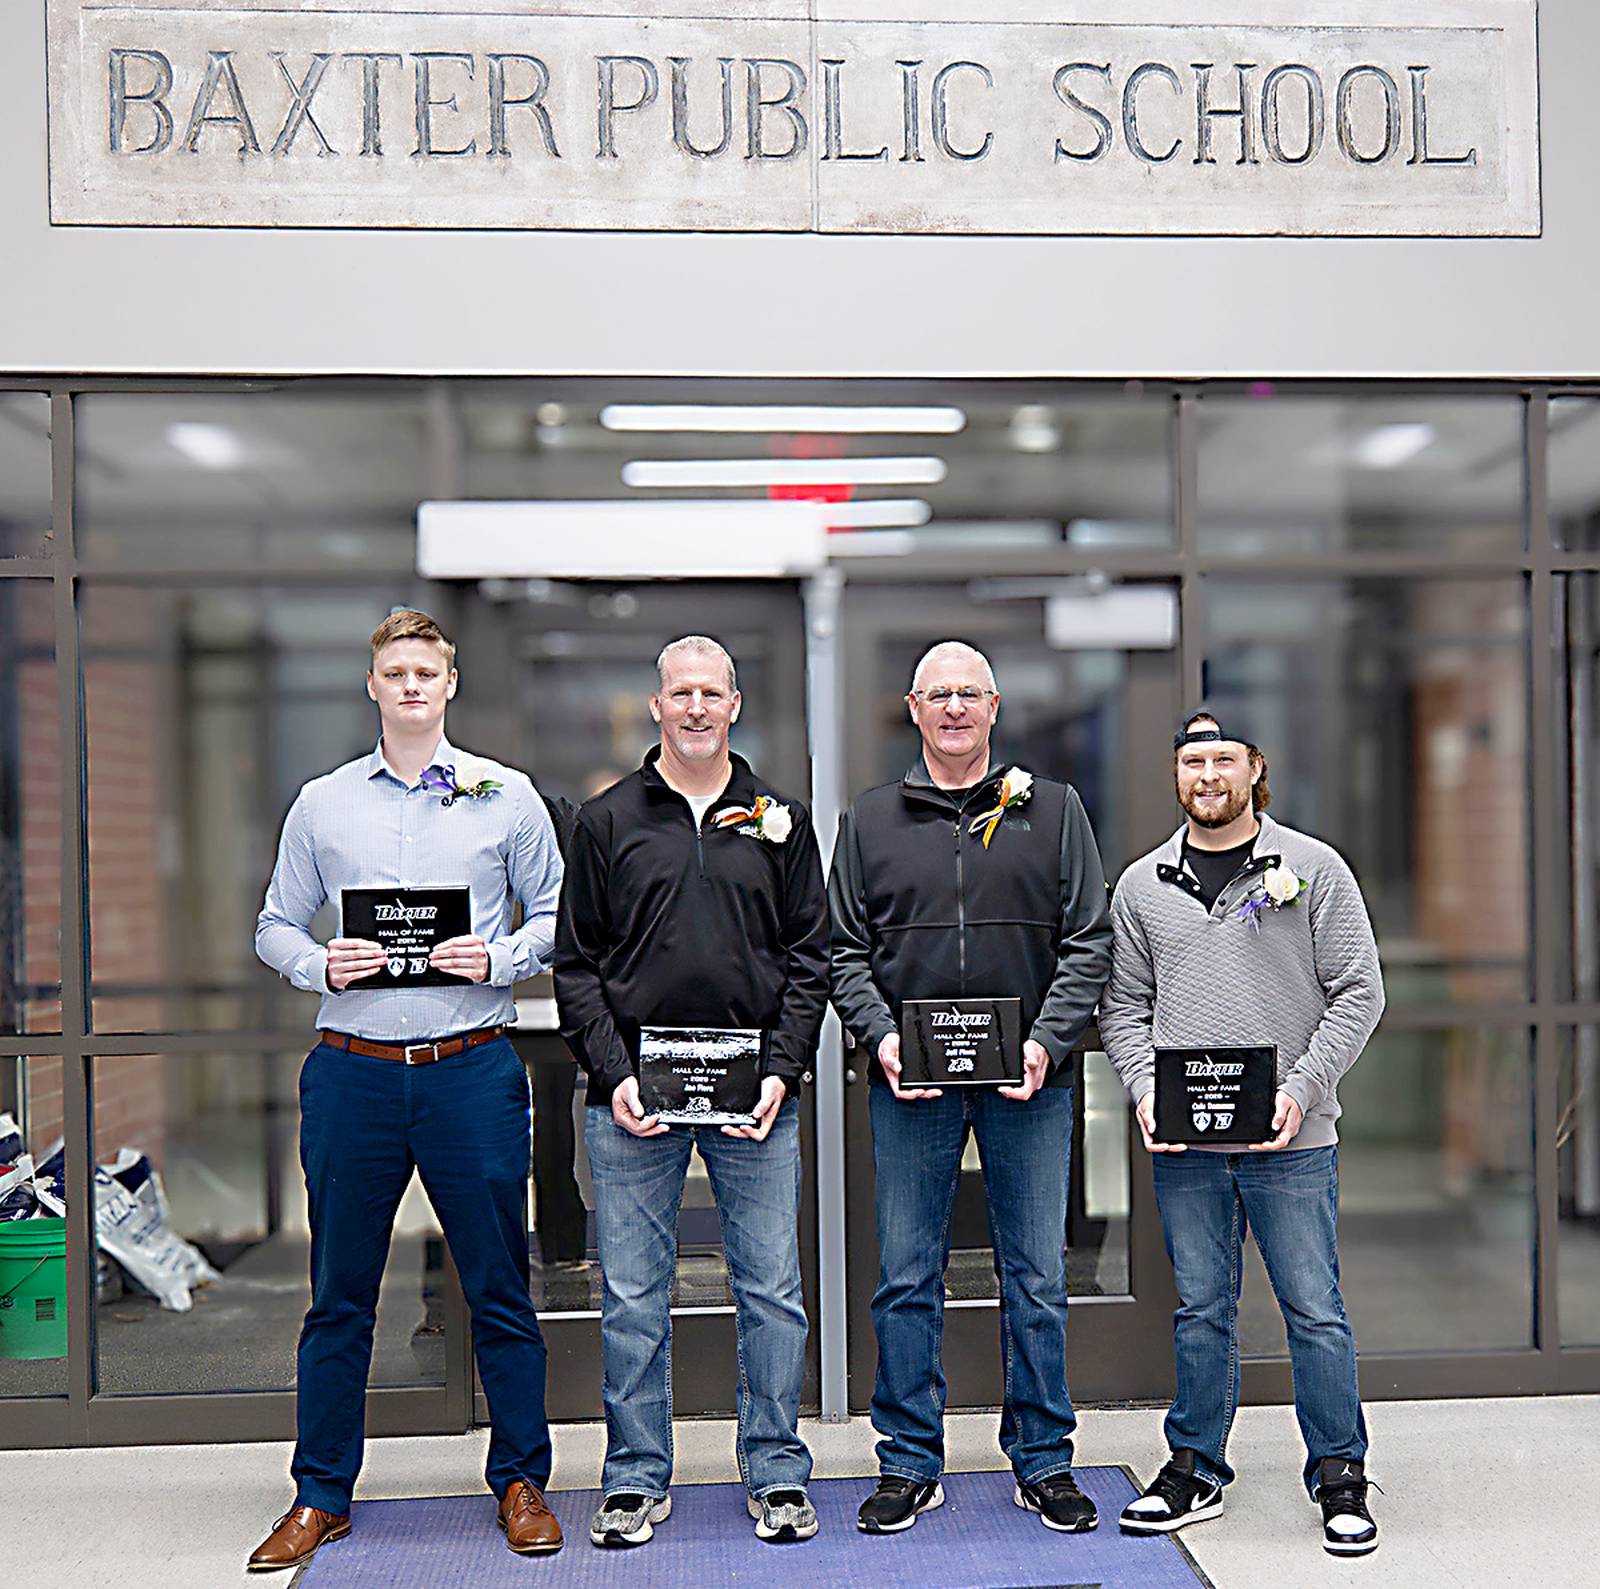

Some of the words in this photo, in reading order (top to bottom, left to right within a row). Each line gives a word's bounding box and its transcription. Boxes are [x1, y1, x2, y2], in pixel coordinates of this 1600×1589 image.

[108, 48, 562, 159] BAXTER
[594, 55, 994, 163] PUBLIC
[1053, 62, 1477, 166] SCHOOL
[378, 929, 398, 937] HALL
[933, 1032, 954, 1040] HALL
[1184, 1057, 1245, 1081] BAXTER
